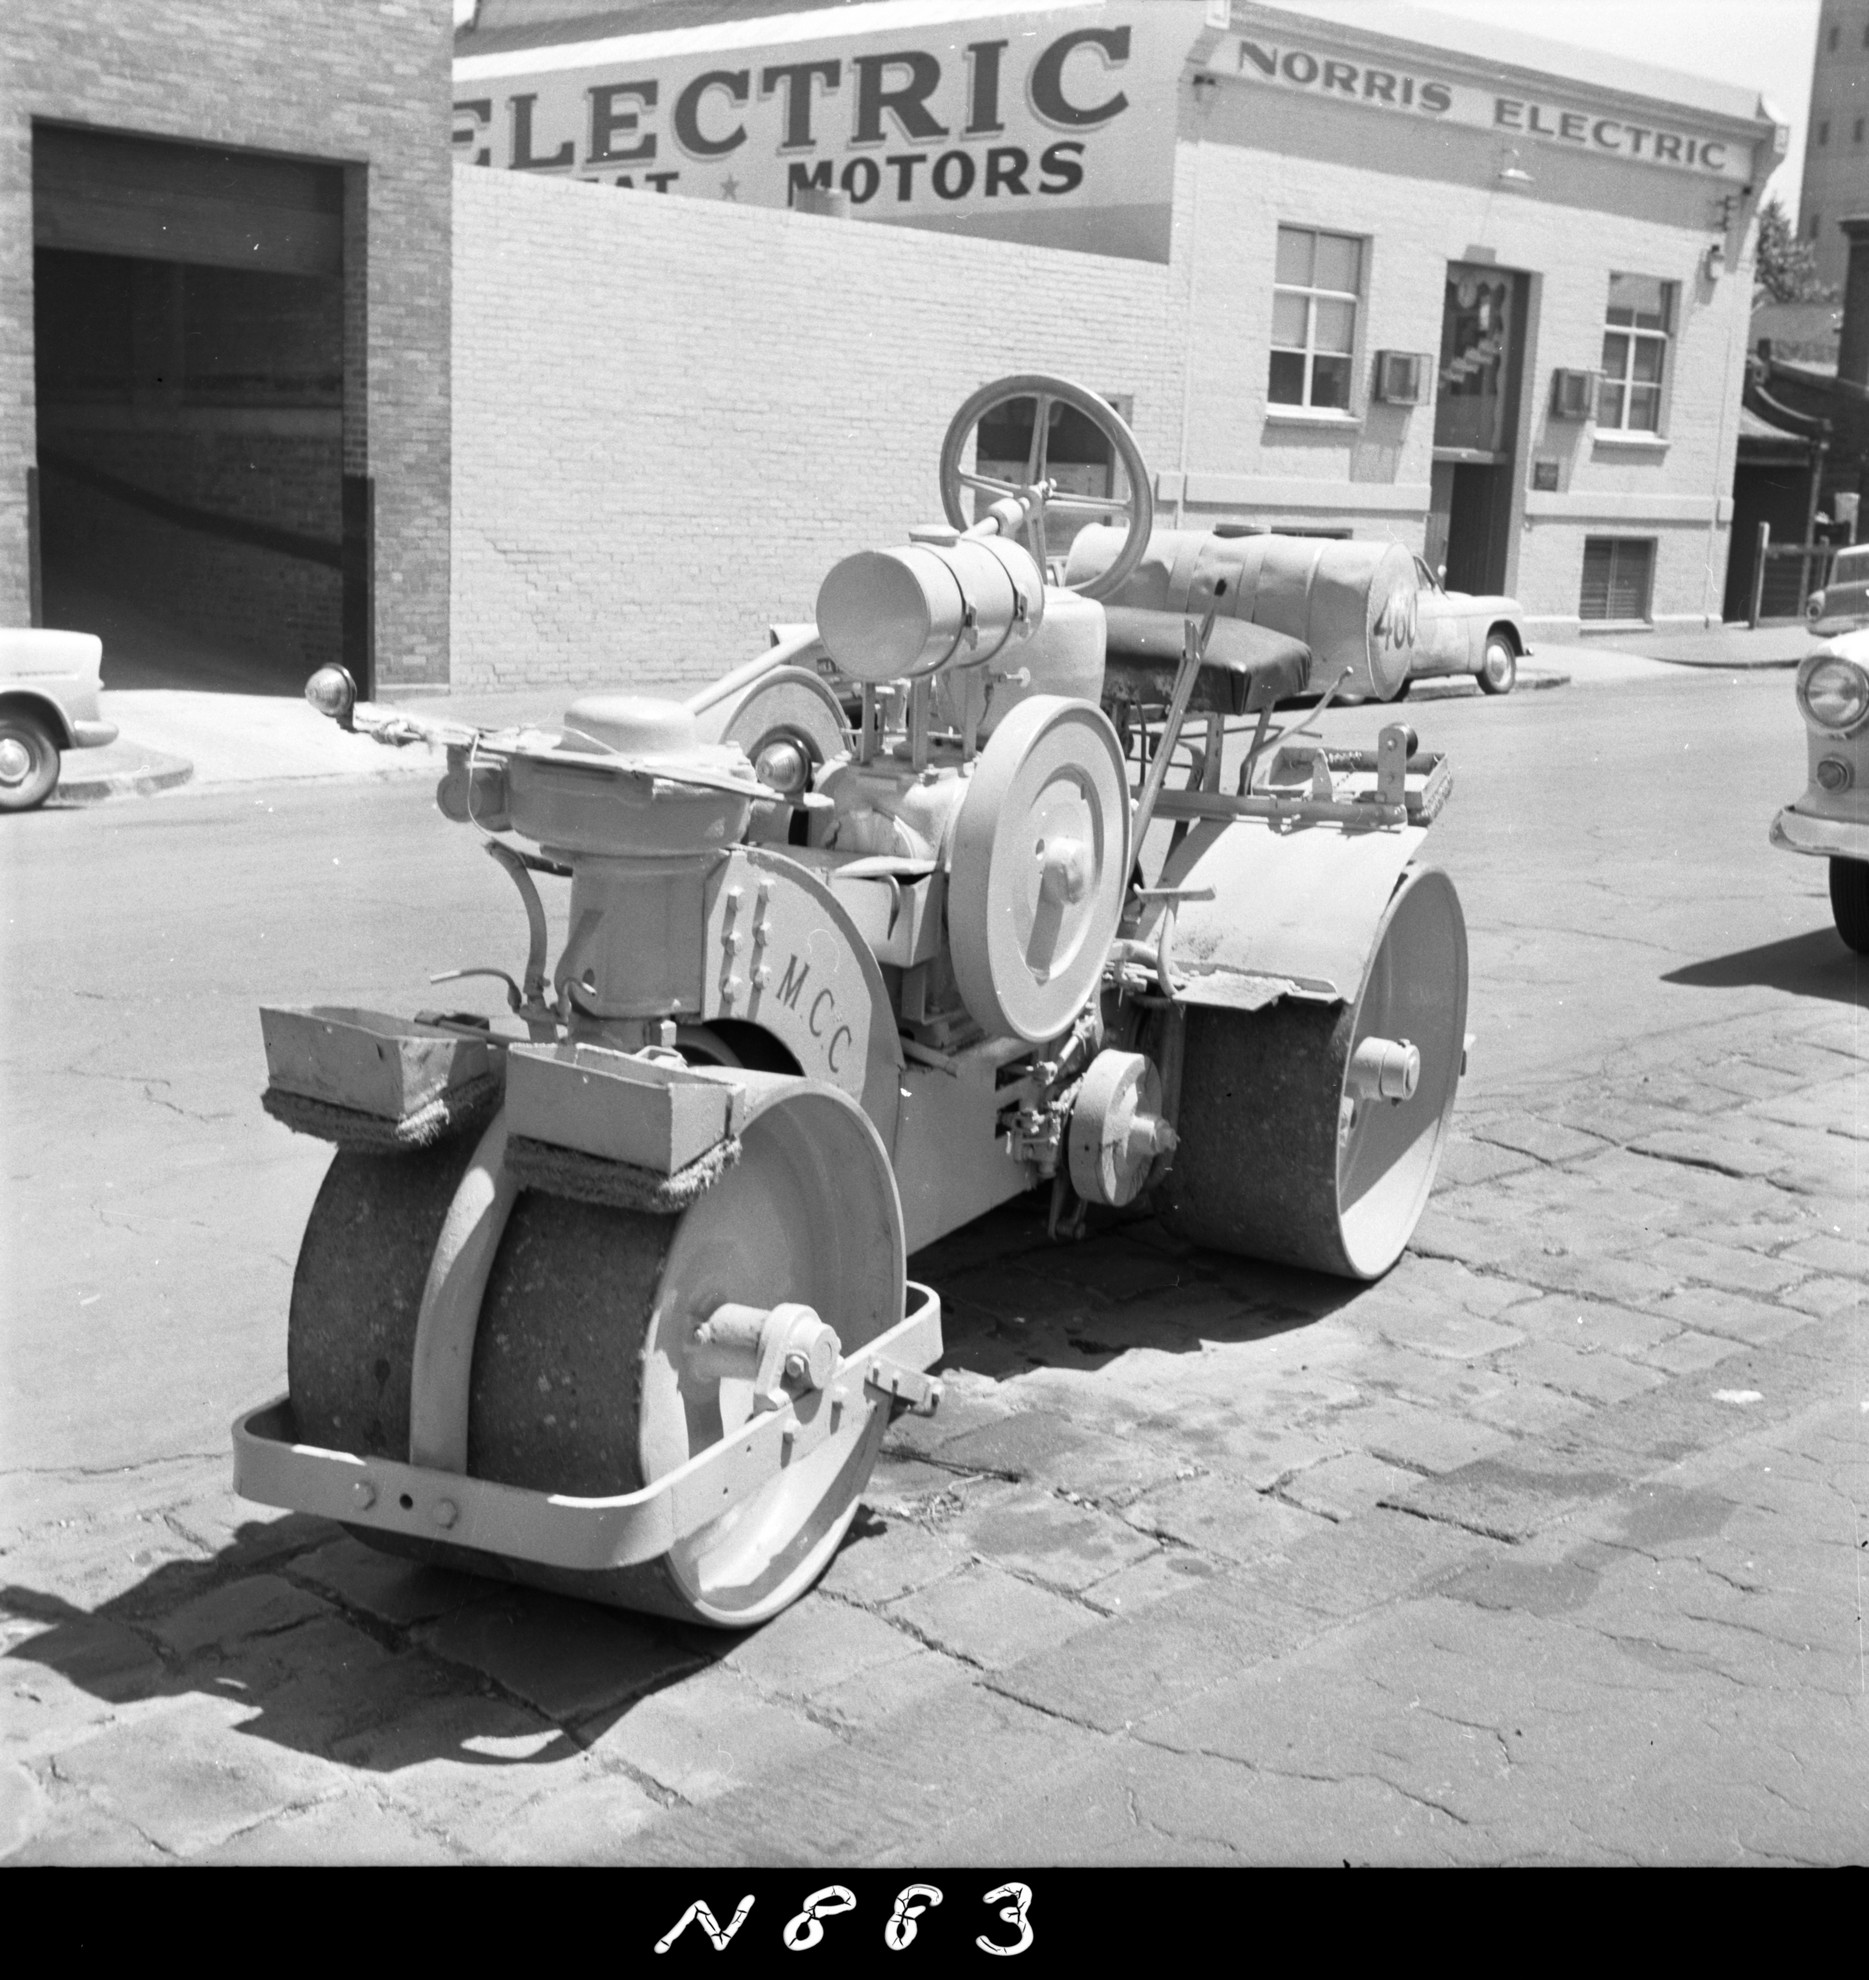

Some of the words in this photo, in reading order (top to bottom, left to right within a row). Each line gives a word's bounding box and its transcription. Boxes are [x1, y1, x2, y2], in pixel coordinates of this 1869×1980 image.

[452, 26, 1132, 172] ELECTRIC
[1239, 41, 1452, 113] NORRIS
[1493, 99, 1726, 171] ELECTRIC
[787, 142, 1085, 206] MOTORS
